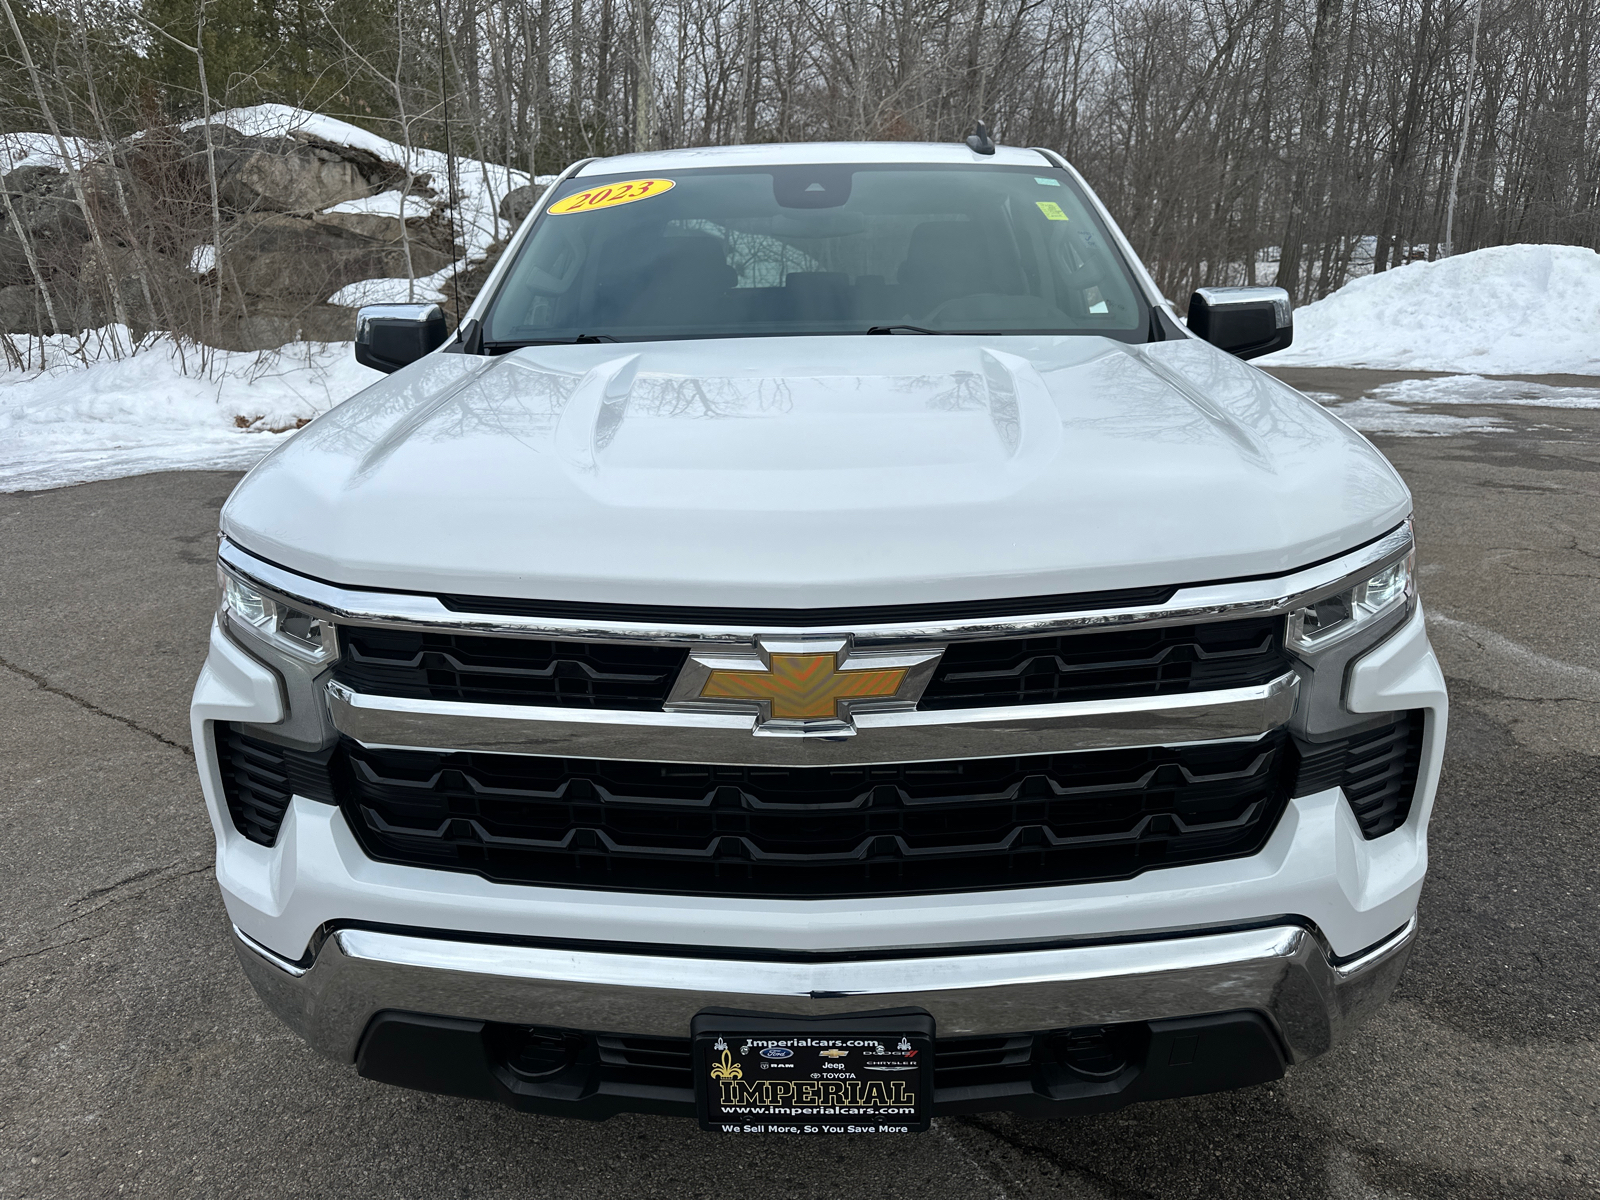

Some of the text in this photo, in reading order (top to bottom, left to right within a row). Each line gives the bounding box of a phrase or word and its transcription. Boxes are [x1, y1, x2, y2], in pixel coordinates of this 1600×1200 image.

[565, 181, 655, 212] 2023
[747, 1038, 879, 1048] Imperialcars.com
[767, 1049, 786, 1057] Ford
[822, 1061, 845, 1070] Jeep
[720, 1080, 915, 1106] IMPERIAL
[721, 1106, 915, 1115] www.imperialcars.com
[721, 1125, 908, 1134] We Sell More, So You Save More
